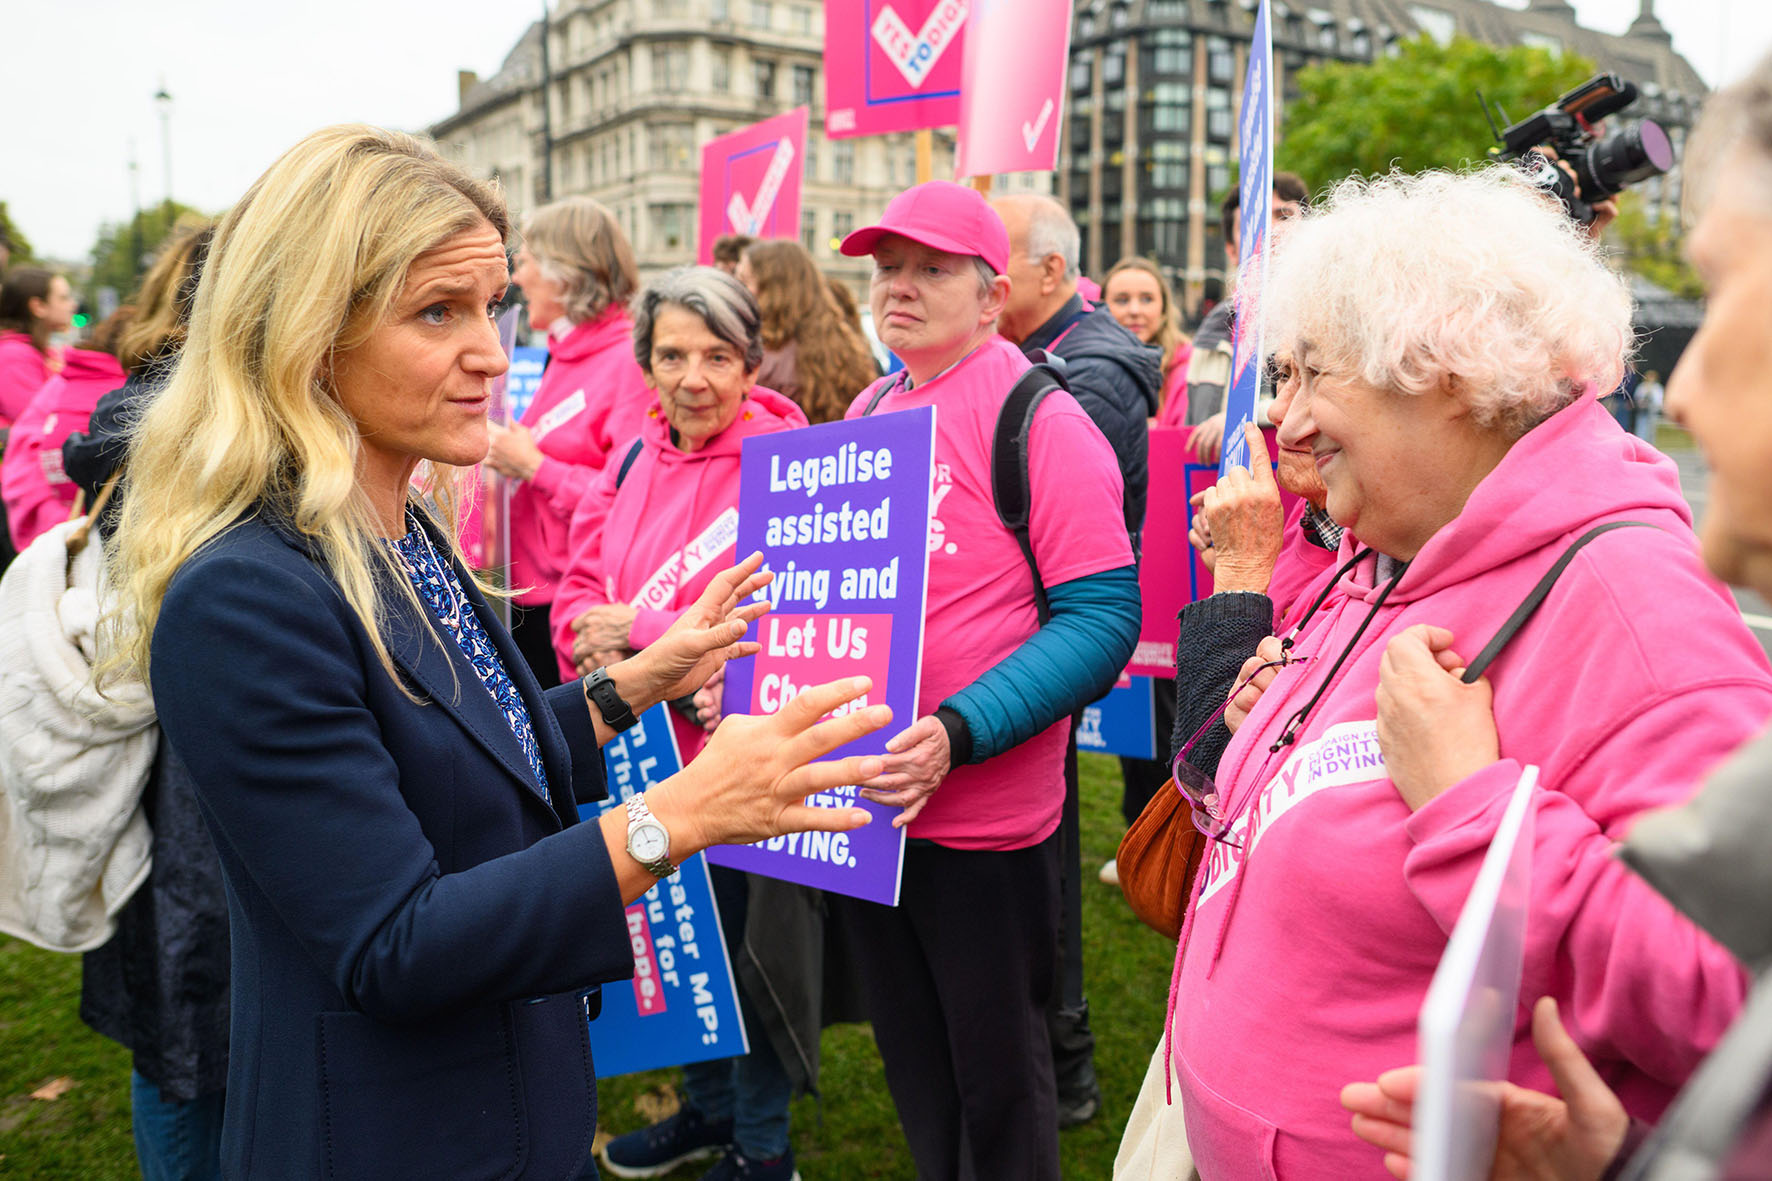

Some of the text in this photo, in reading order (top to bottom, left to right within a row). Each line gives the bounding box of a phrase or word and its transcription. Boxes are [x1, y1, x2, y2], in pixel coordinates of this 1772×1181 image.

[908, 42, 932, 73] TO
[770, 441, 893, 498] Legalise
[765, 496, 890, 547] assisted
[840, 556, 899, 599] and
[768, 617, 868, 660] Let Us
[626, 911, 656, 1010] hope.
[655, 934, 680, 988] for
[689, 972, 719, 1046] MP:
